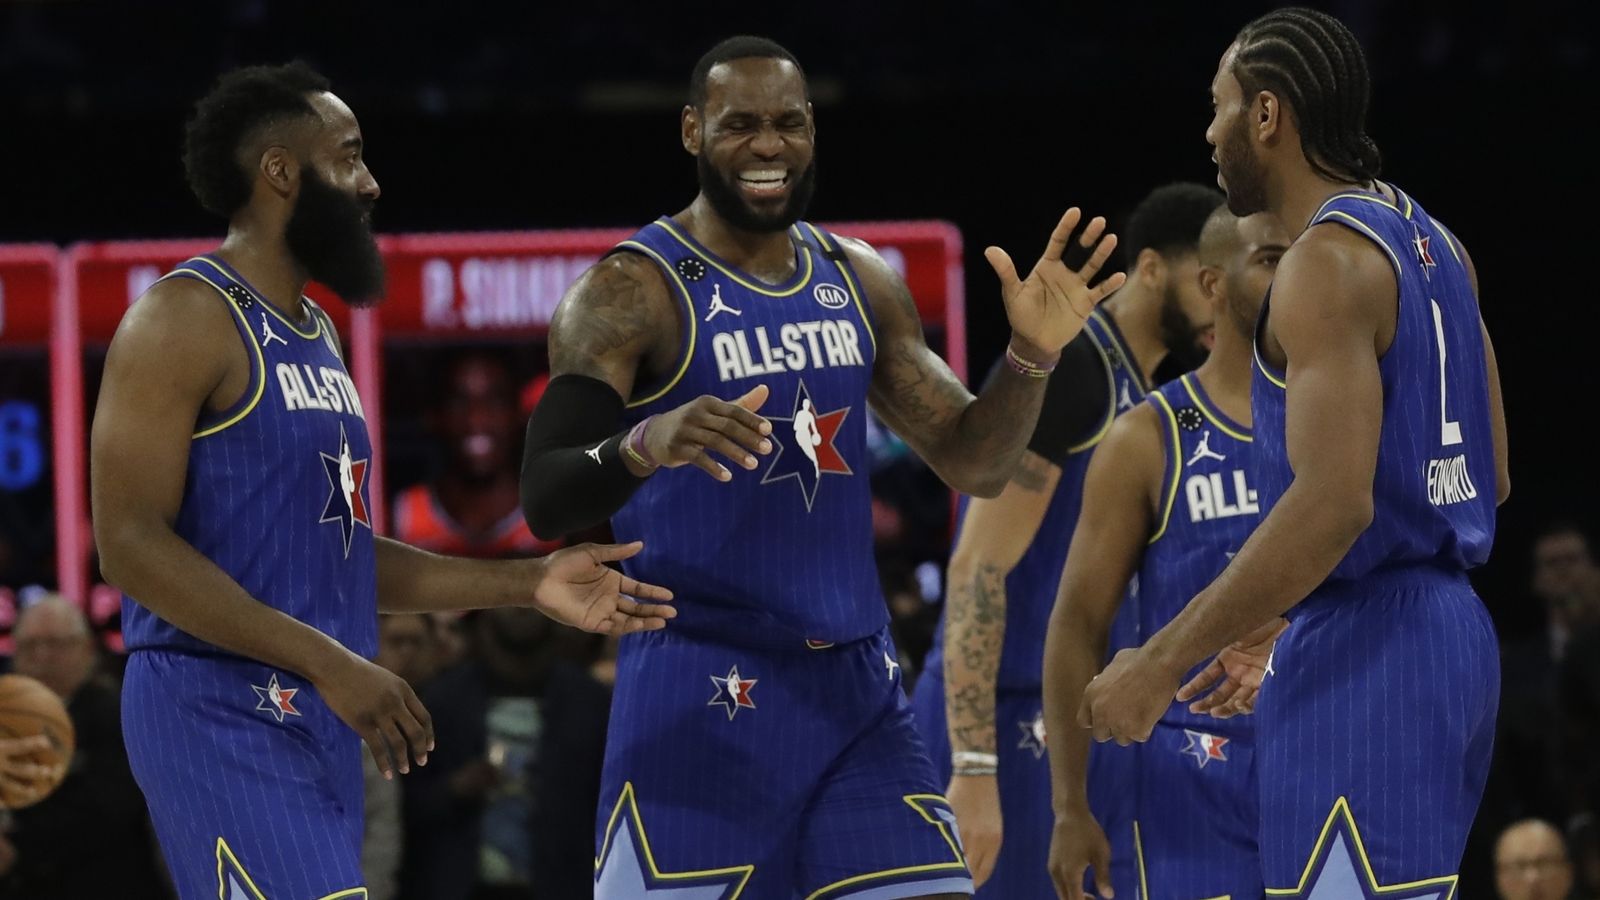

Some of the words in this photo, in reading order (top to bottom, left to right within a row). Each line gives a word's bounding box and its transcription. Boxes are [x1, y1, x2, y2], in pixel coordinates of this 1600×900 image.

[818, 288, 844, 304] KIA
[712, 319, 865, 382] ALL-STAR
[1422, 454, 1477, 506] EONARD
